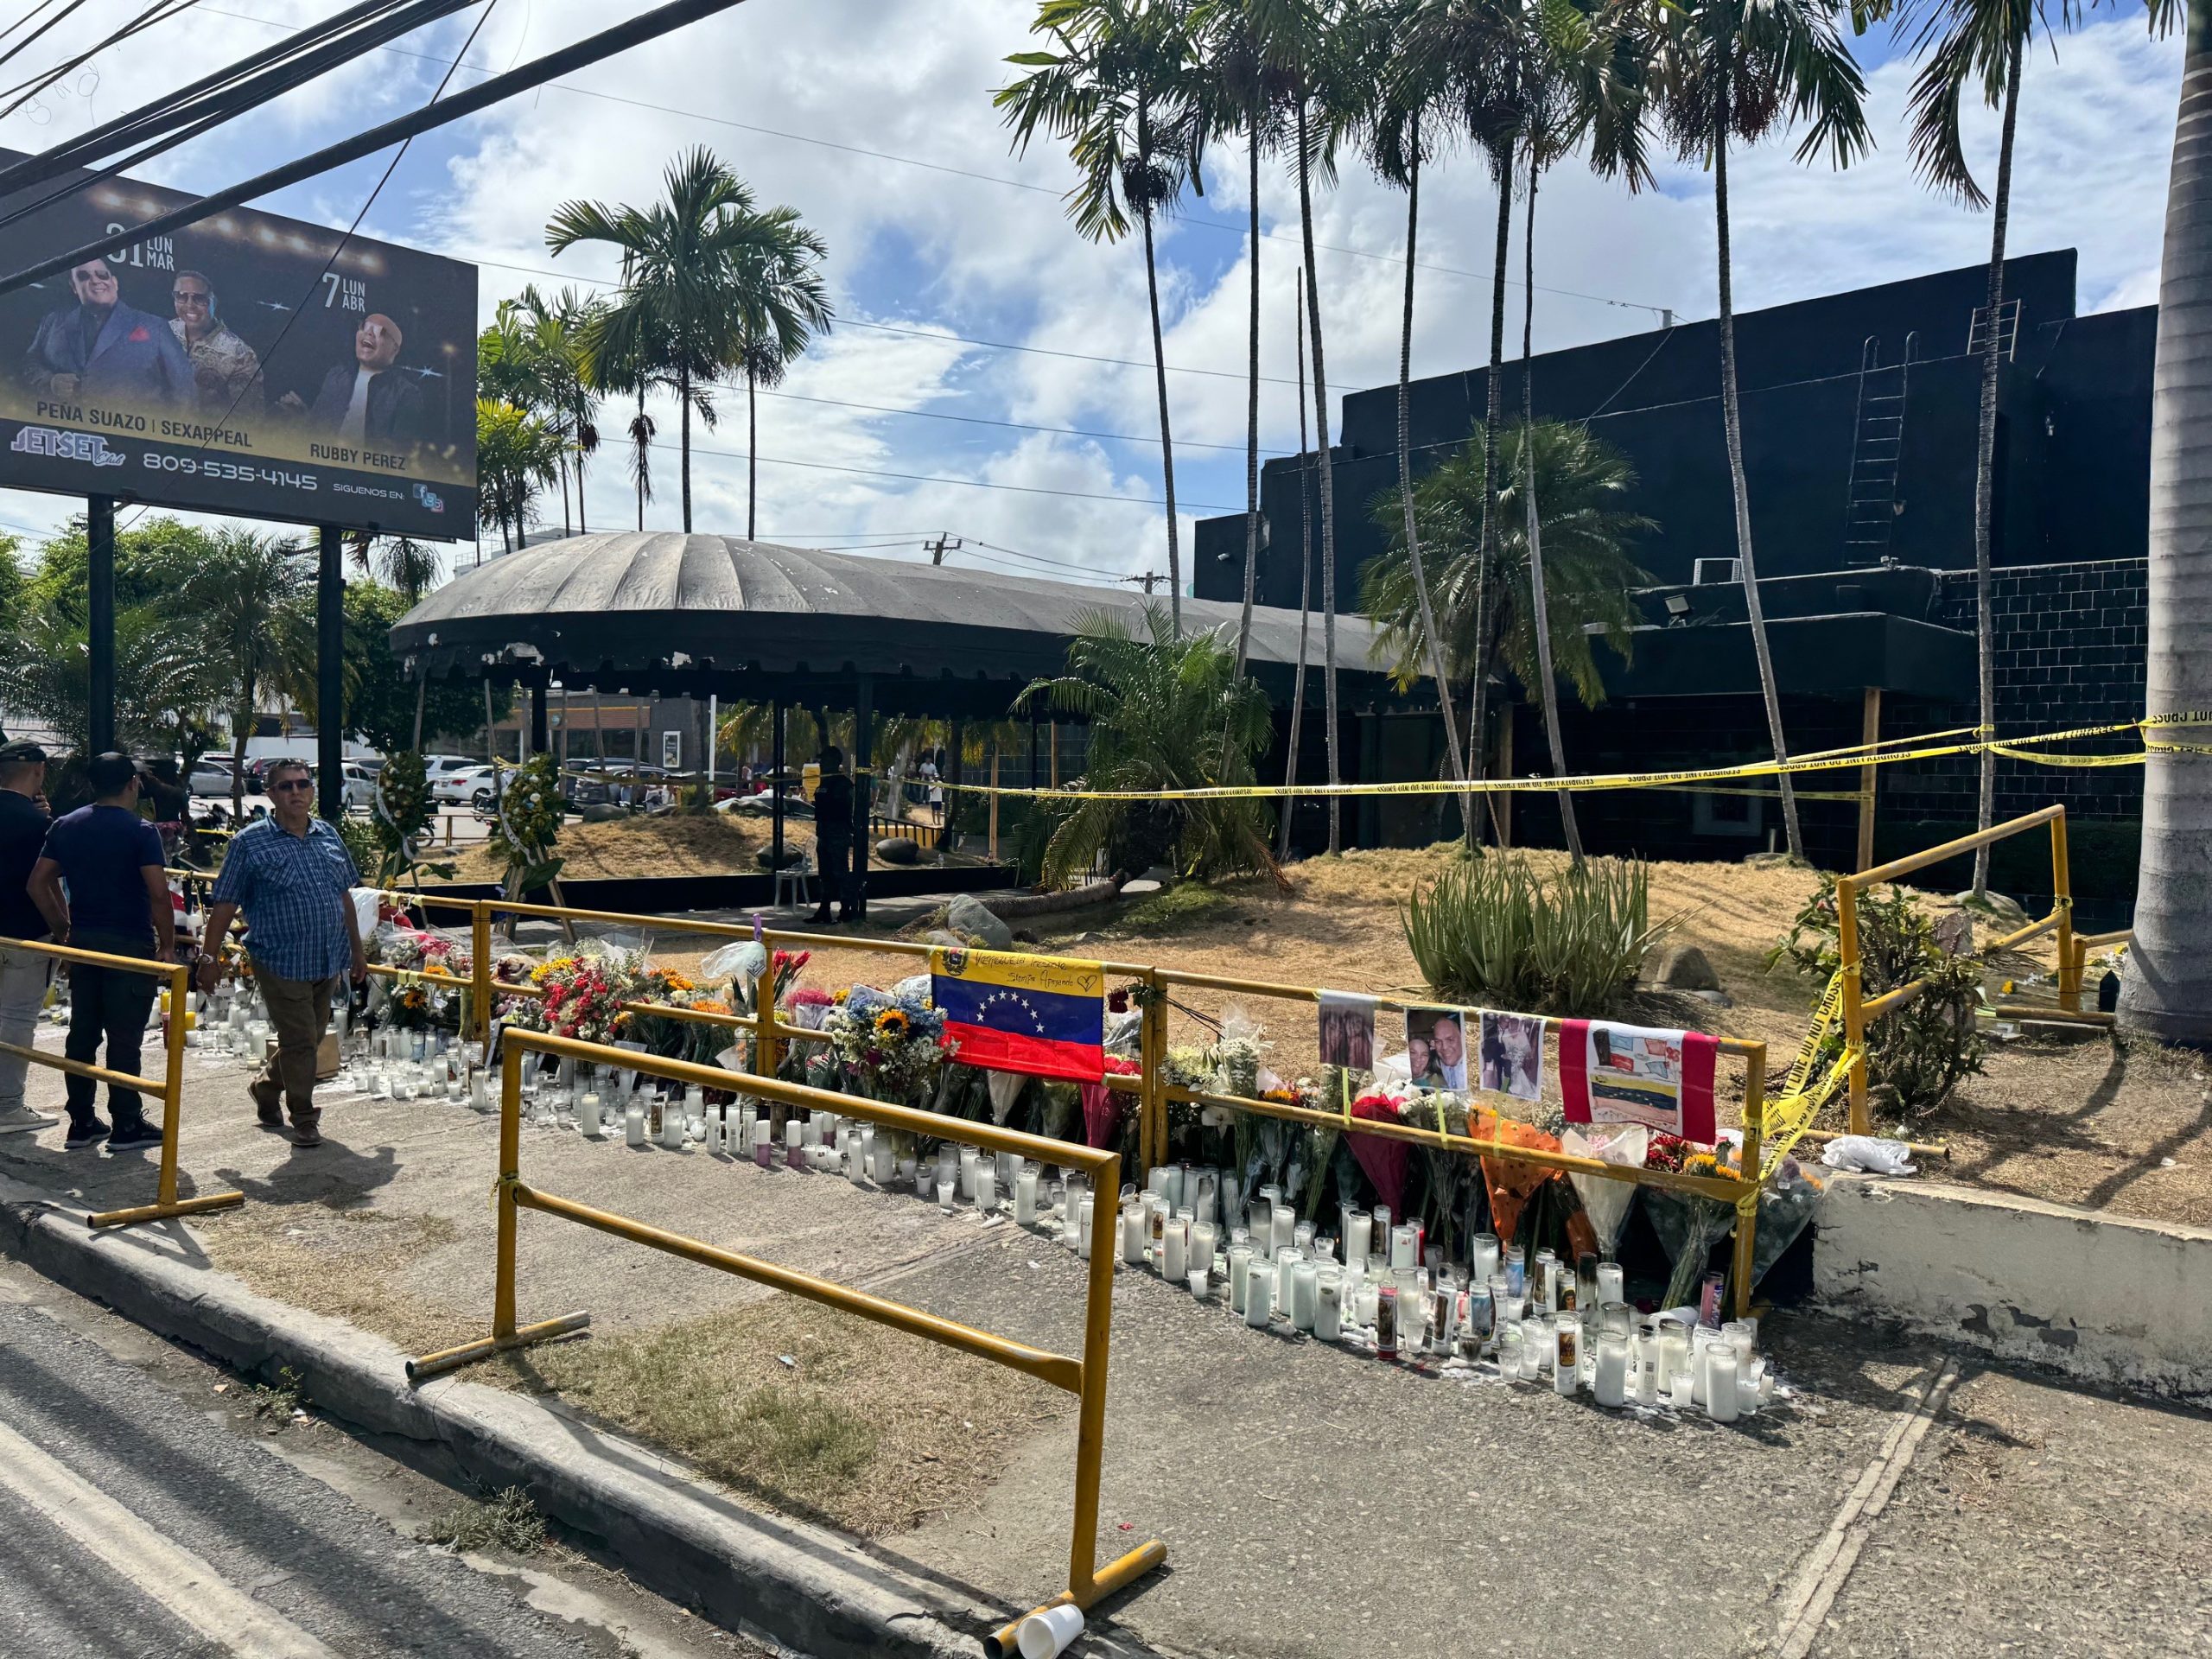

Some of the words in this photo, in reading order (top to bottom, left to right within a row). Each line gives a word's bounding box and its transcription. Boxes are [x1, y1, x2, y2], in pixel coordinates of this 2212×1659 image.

[147, 236, 173, 254] LUN
[147, 250, 175, 271] MAR
[322, 272, 340, 308] 7
[343, 278, 365, 297] LUN
[342, 294, 365, 313] ABR
[37, 401, 83, 423] PEÑA
[90, 409, 146, 432] SUAZO
[162, 420, 252, 448] SEXAPPEAL
[11, 426, 110, 462] JETSET
[310, 444, 359, 465] RUBBY
[363, 452, 406, 471] PEREZ
[95, 453, 126, 467] Club
[143, 453, 317, 491] 809-535-4145
[333, 483, 387, 499] SIGUENOS
[1791, 1058, 1808, 1084] LINE
[1801, 1039, 1814, 1058] DO
[1809, 1018, 1825, 1040] NOT
